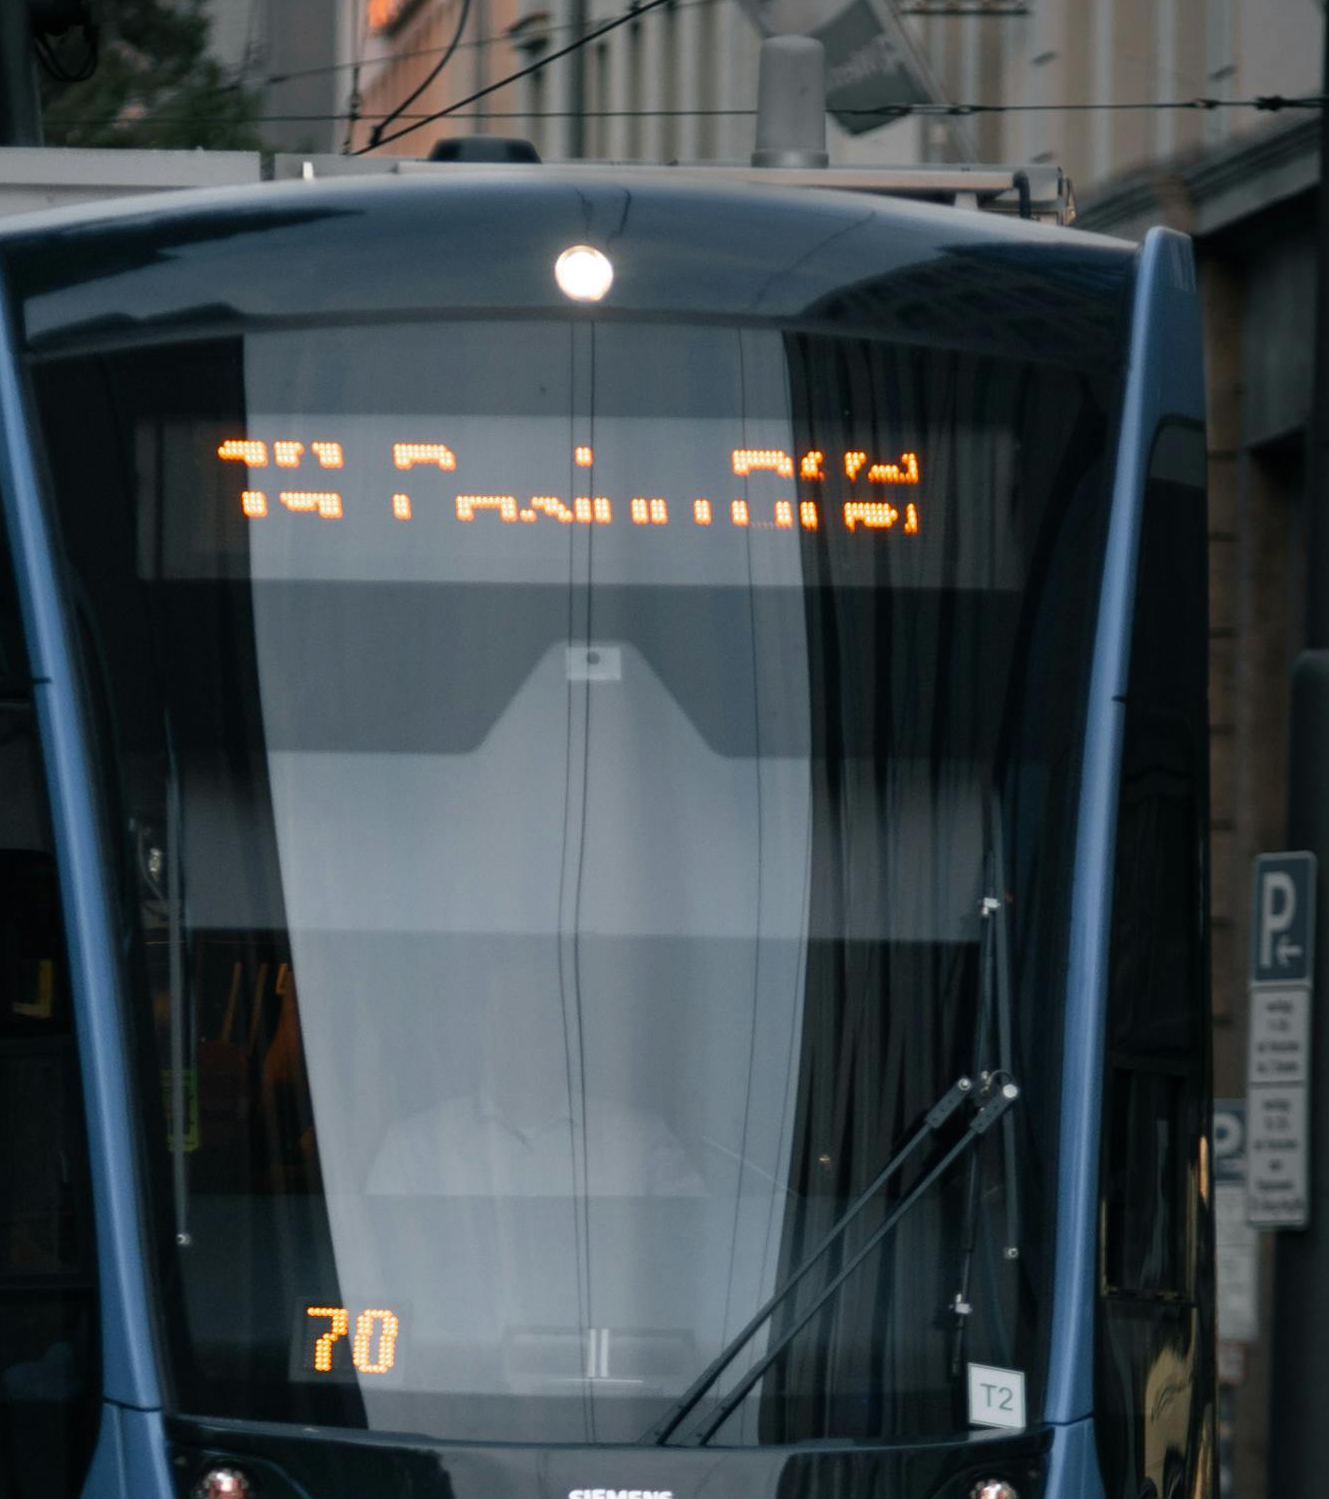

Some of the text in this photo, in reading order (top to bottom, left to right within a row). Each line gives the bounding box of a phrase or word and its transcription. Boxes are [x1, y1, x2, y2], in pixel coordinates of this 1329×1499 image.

[1258, 870, 1297, 969] P
[307, 1306, 399, 1373] 70
[979, 1382, 1014, 1412] T2
